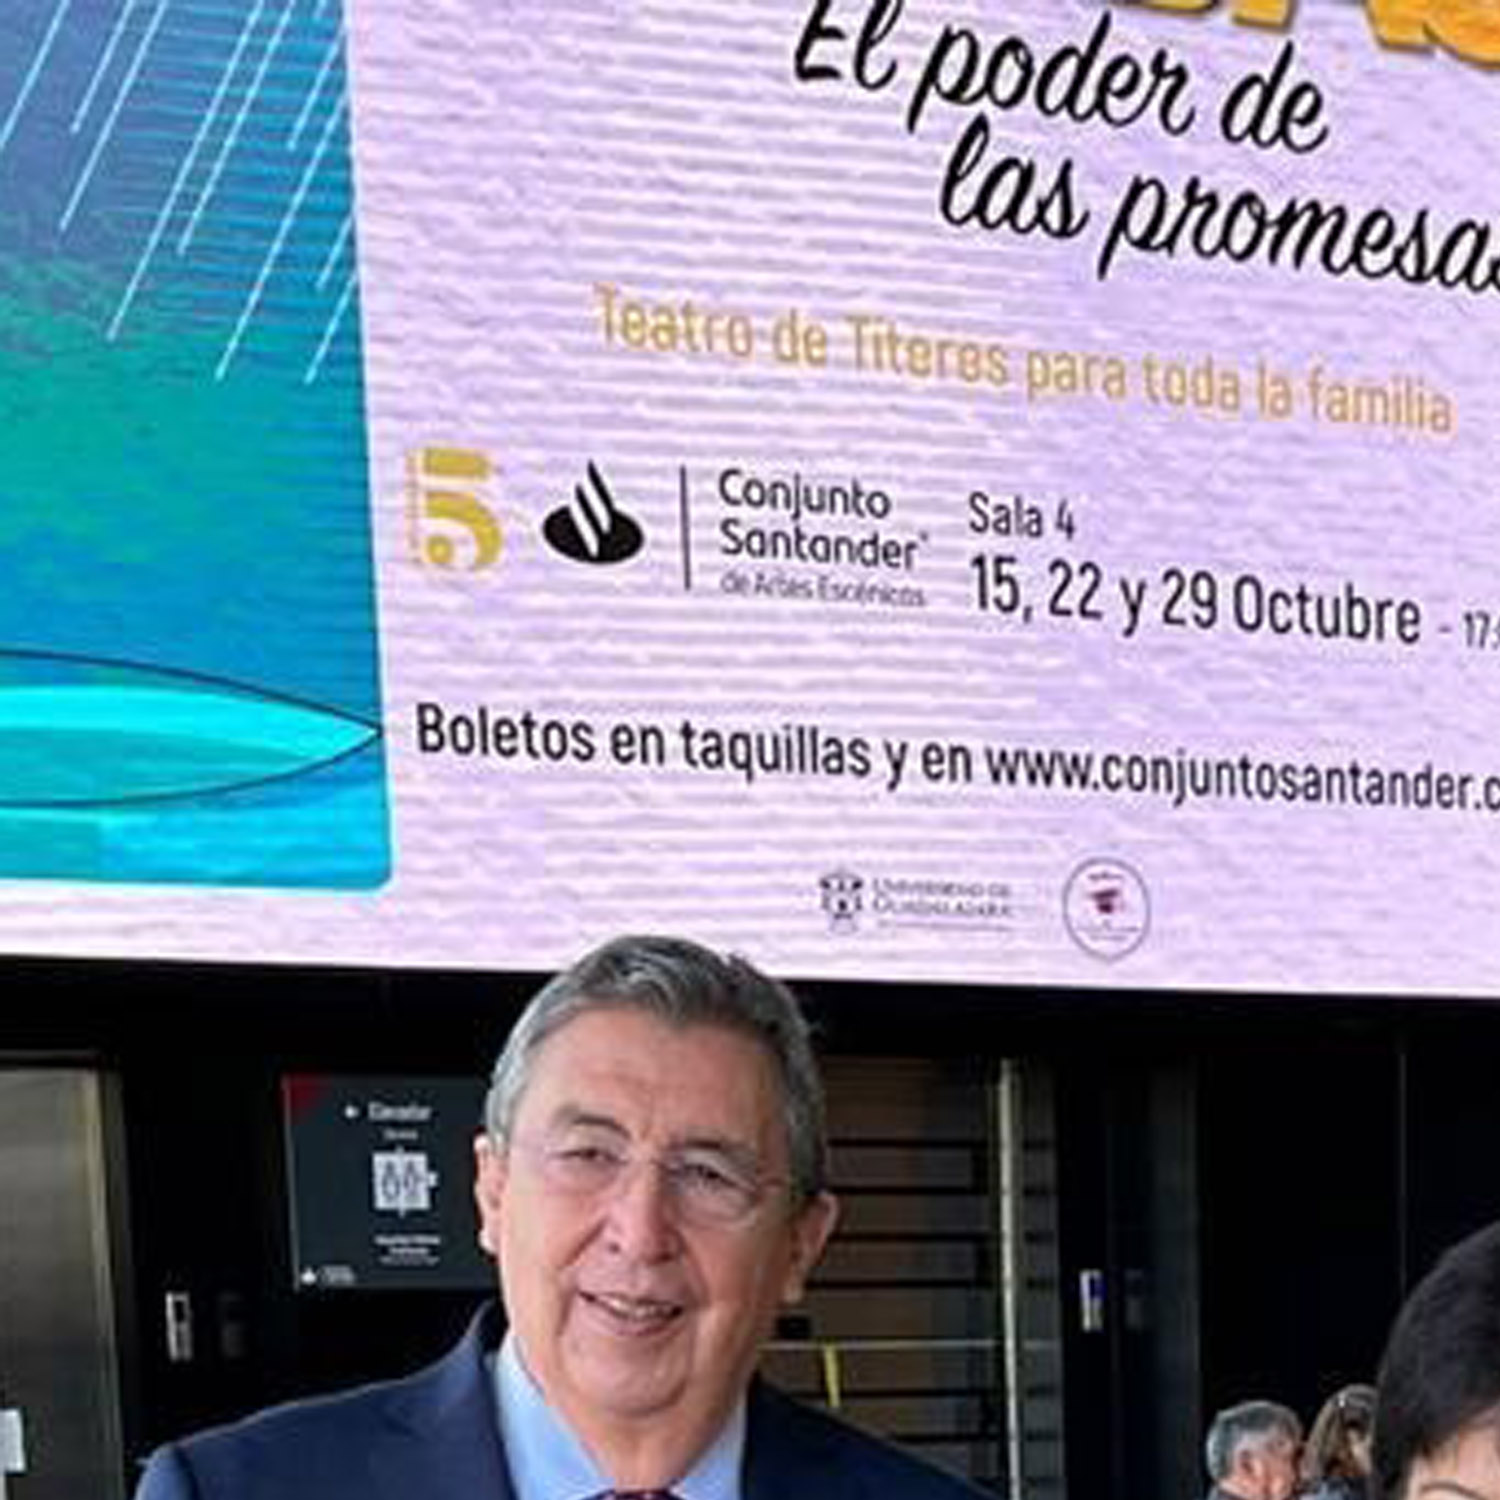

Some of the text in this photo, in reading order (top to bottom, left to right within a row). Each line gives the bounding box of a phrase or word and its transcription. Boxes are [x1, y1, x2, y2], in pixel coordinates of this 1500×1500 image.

[794, 0, 898, 91] El
[907, 11, 1197, 136] poder
[1220, 40, 1328, 153] de
[939, 113, 1090, 239] las
[594, 283, 752, 358] Teatro
[772, 306, 828, 368] de
[1026, 349, 1127, 400] para
[1141, 352, 1241, 412] toda
[1256, 357, 1293, 418] la
[1307, 363, 1453, 433] familia
[718, 467, 892, 522] Conjunto
[969, 491, 1076, 541] Sala 4
[970, 552, 1032, 624] 15,
[1048, 557, 1104, 621] 22
[1119, 576, 1147, 638] y
[1162, 566, 1219, 630] 29
[1233, 574, 1422, 645] Octubre
[416, 702, 596, 763] Boletos
[609, 722, 665, 766] en
[680, 720, 872, 784] taquillas
[883, 739, 909, 791] y
[921, 741, 972, 783] en
